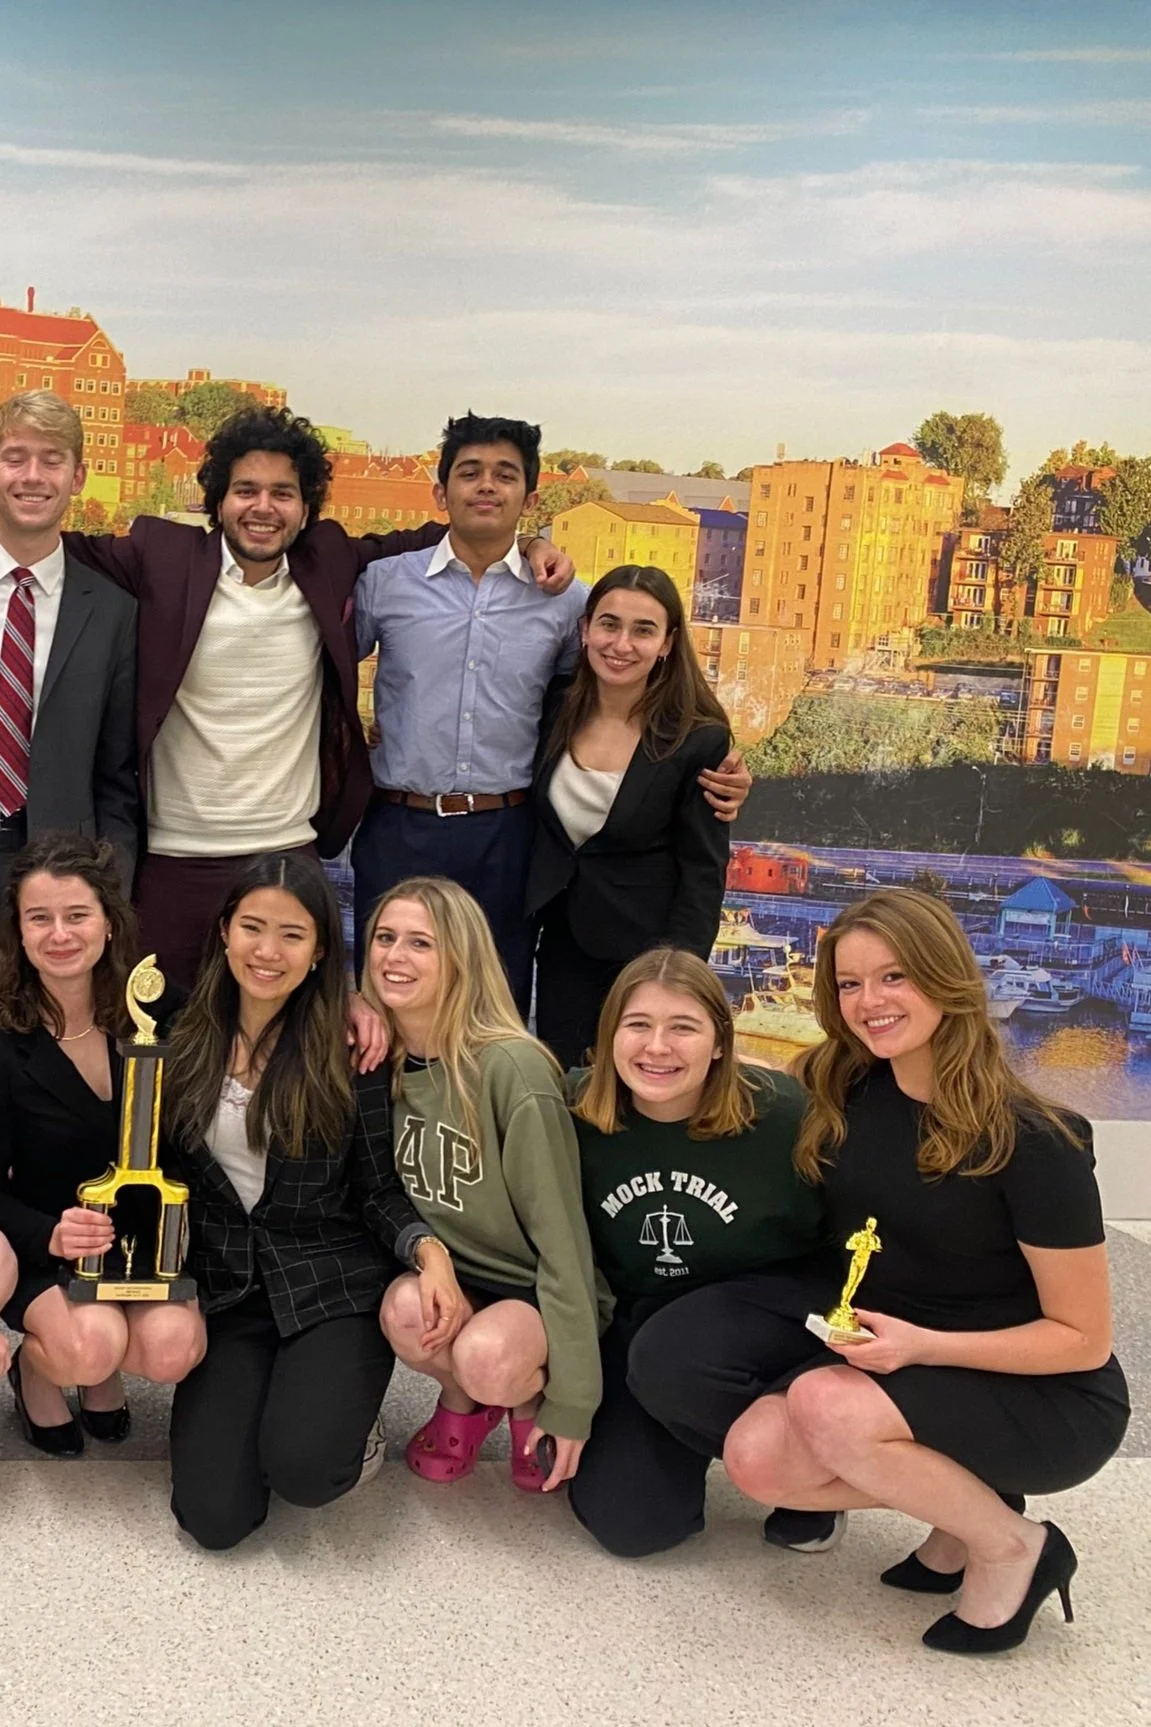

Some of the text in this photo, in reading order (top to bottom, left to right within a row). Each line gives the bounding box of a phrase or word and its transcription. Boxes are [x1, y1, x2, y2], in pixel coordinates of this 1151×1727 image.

[600, 1171, 739, 1224] MOCK TRIAL
[669, 1266, 689, 1277] 2011
